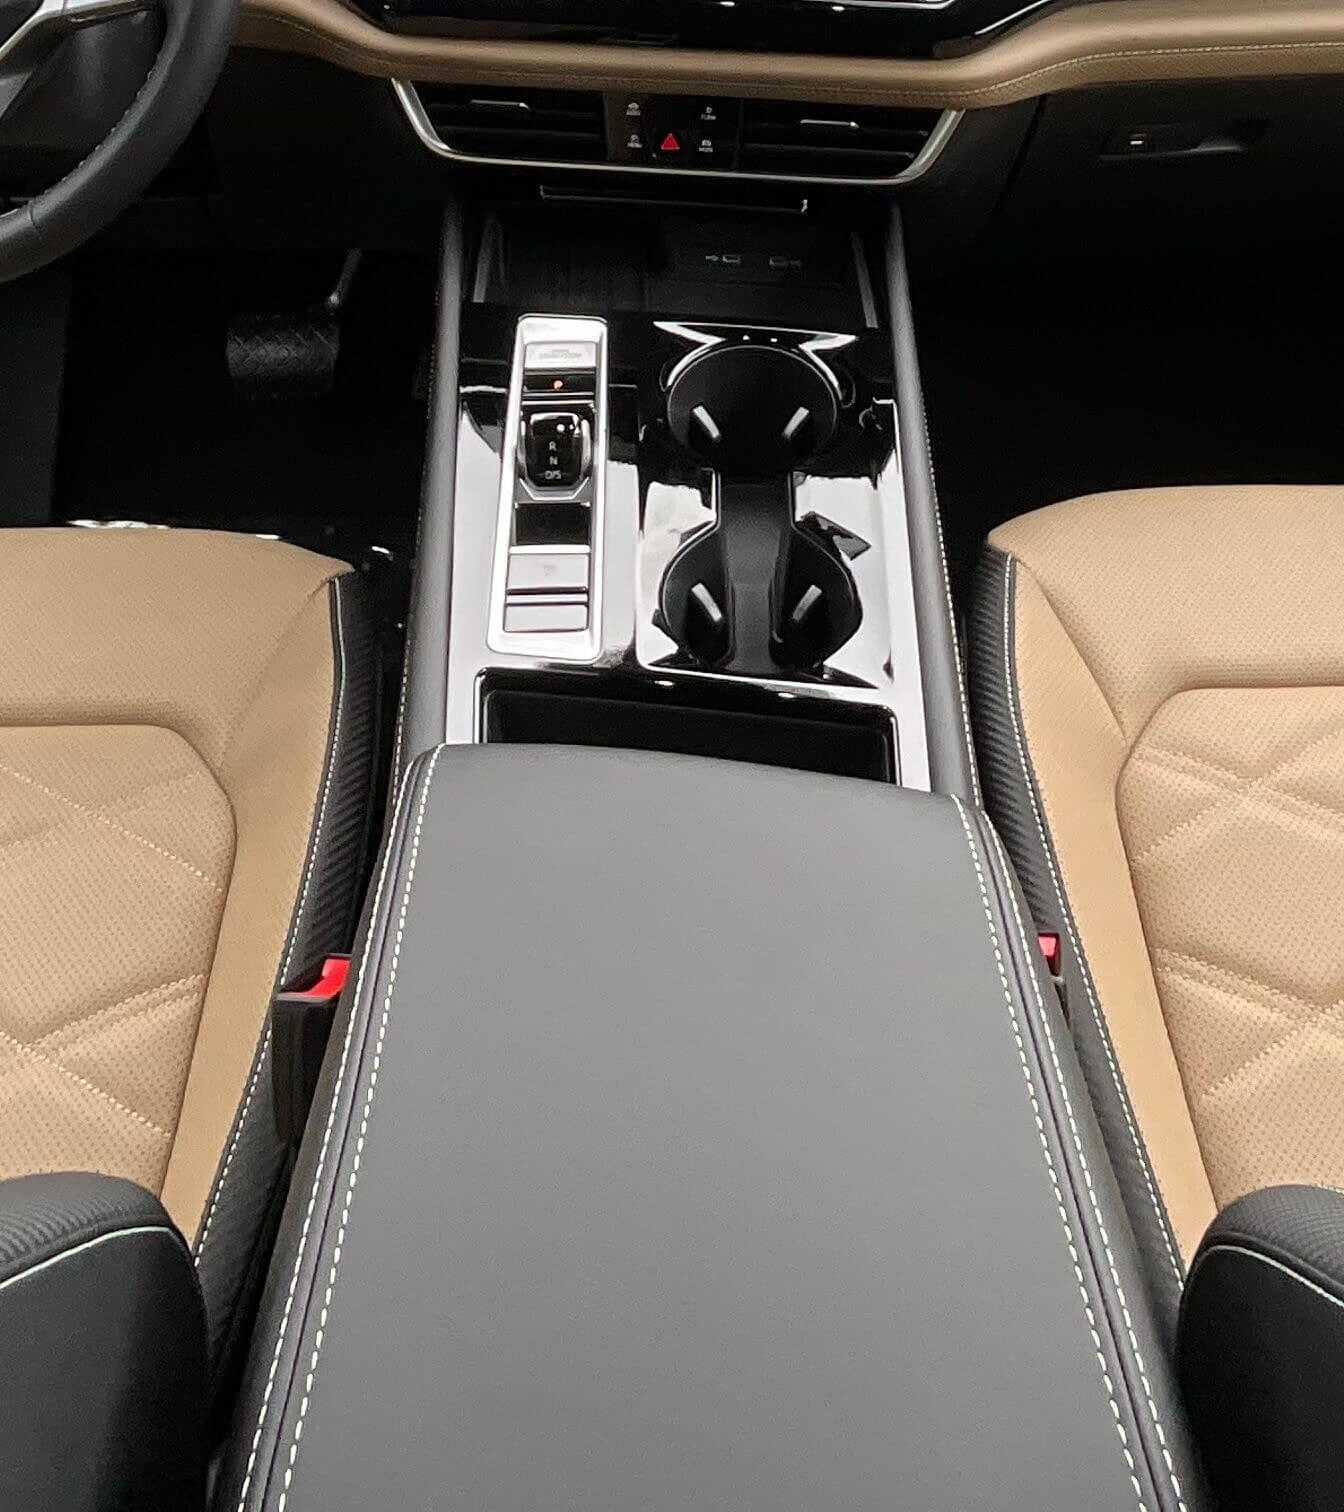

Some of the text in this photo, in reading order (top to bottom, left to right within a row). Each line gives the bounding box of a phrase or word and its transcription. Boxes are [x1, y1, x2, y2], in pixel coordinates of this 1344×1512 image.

[549, 441, 557, 451] R
[549, 455, 558, 465] N
[544, 469, 562, 480] D/S
